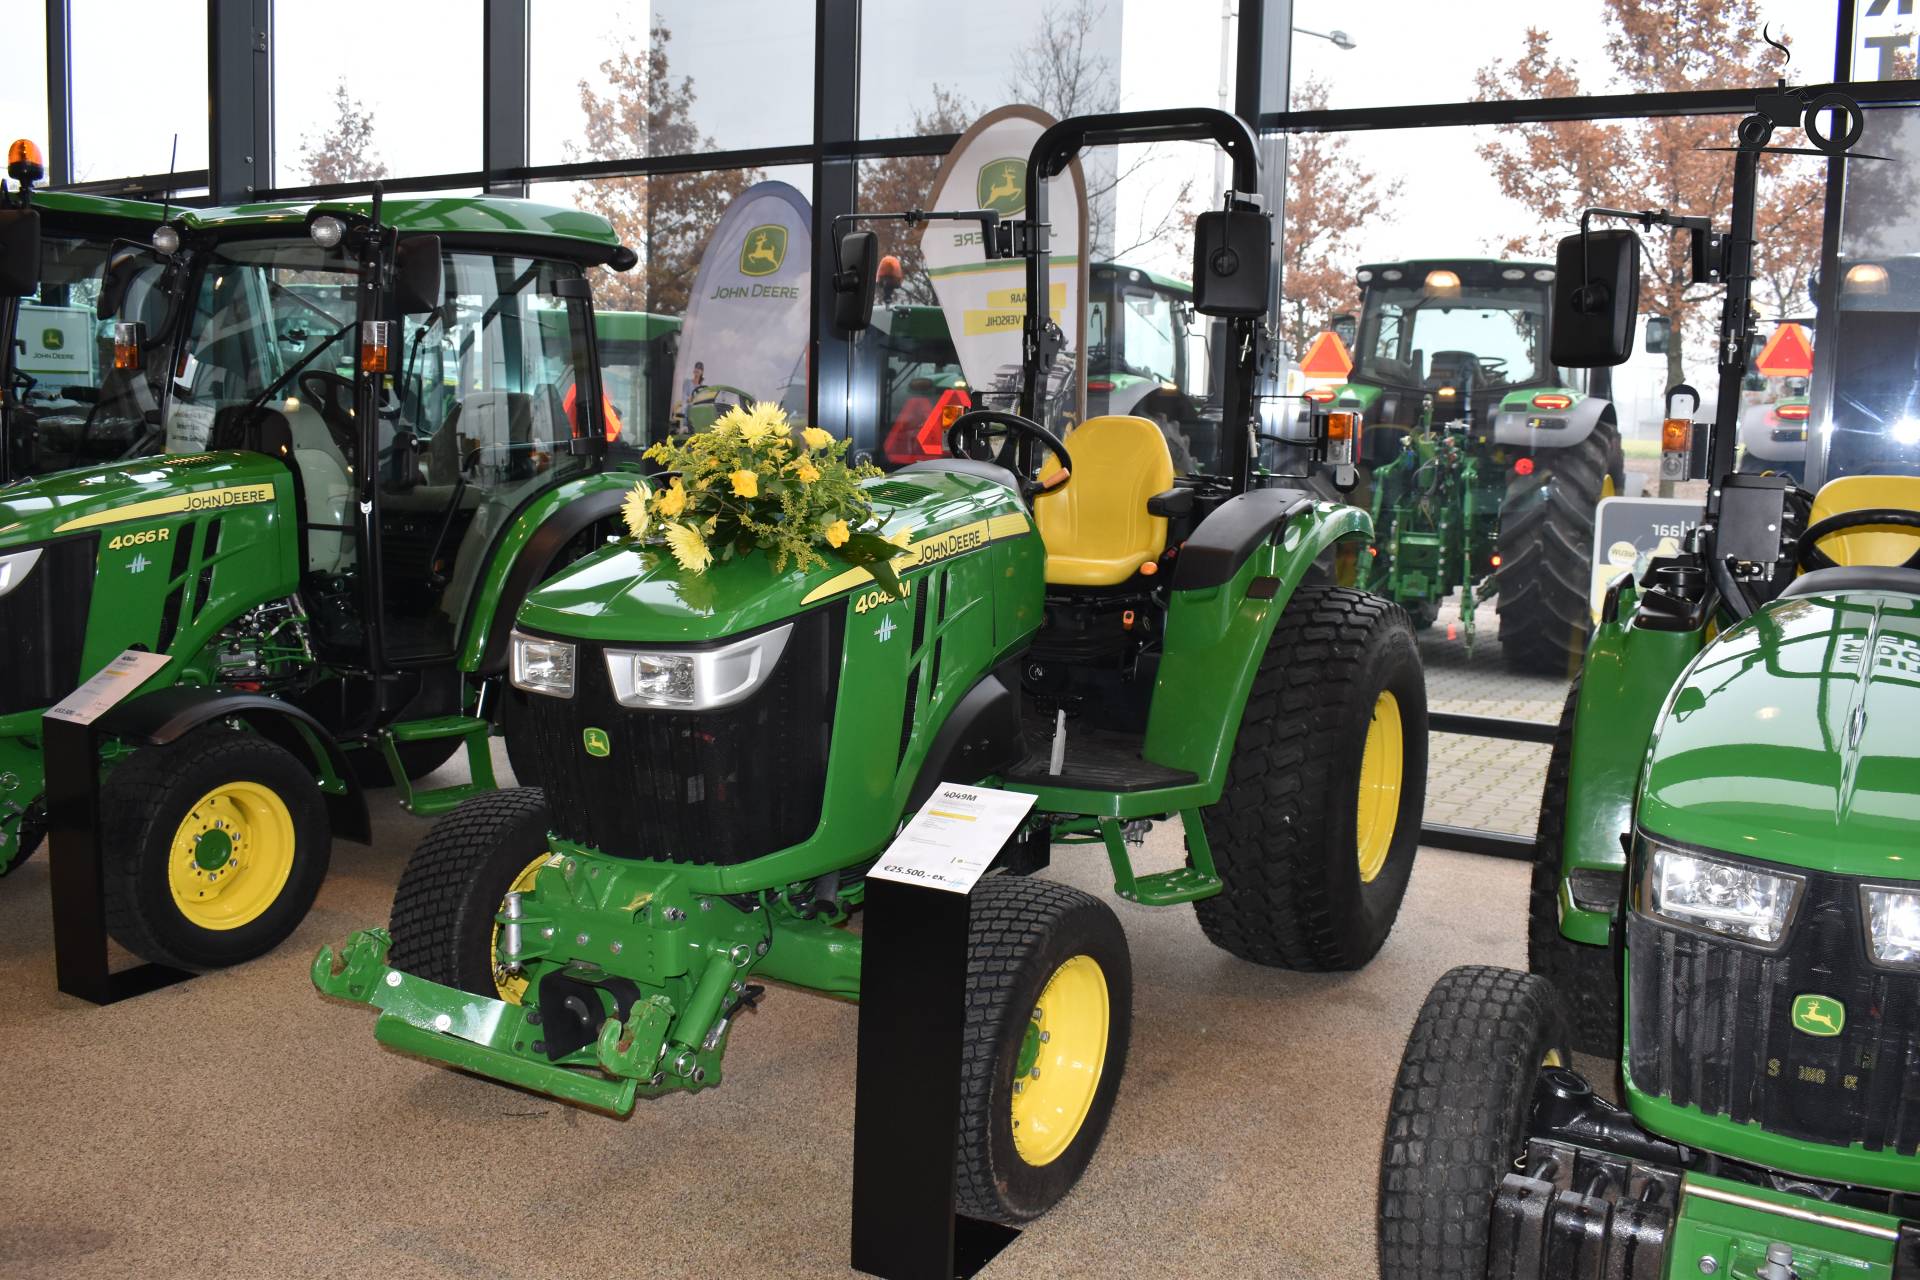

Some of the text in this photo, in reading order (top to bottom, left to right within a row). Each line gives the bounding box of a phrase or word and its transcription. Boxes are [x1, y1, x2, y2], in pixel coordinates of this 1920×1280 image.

[710, 283, 799, 300] JOHN DEERE
[33, 352, 74, 360] JOHN DEERE
[184, 490, 266, 511] JOHN DEERE
[918, 530, 981, 564] JOHN DEERE
[943, 790, 978, 803] 4049M
